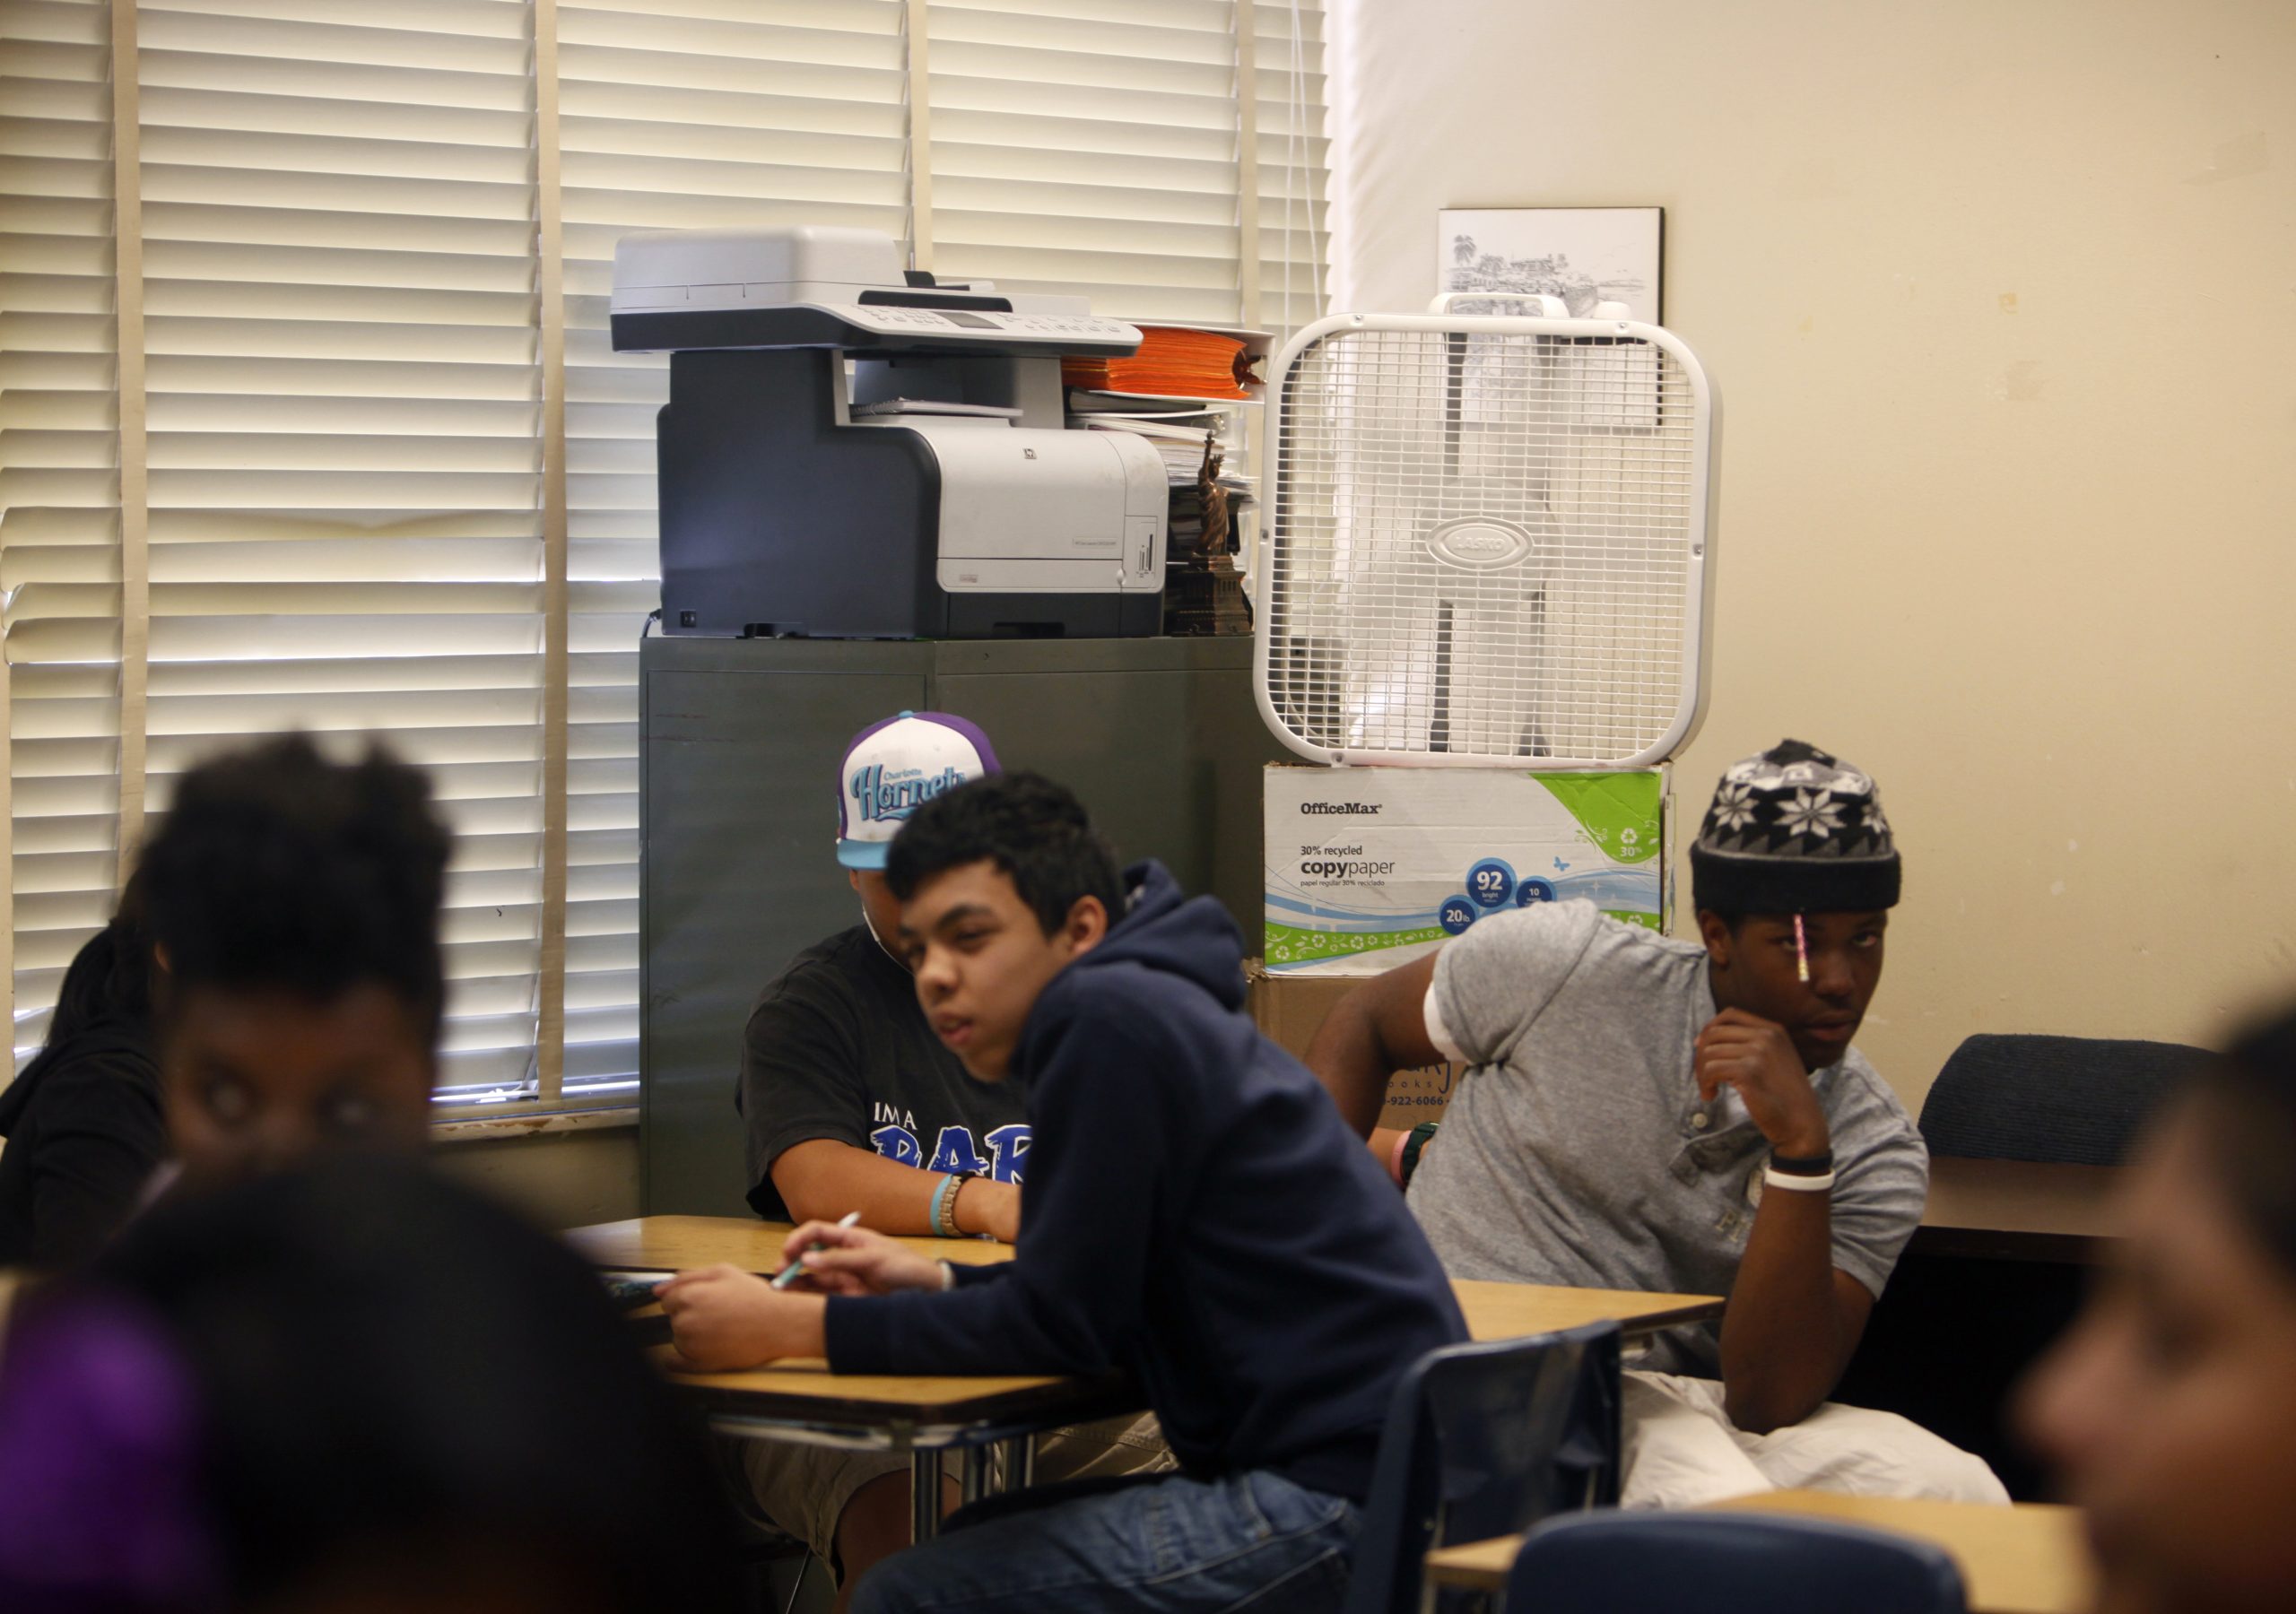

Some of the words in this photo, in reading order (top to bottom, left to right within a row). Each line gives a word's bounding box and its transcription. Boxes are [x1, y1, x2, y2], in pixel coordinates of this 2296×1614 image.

[1300, 846, 1321, 855] 30%
[1324, 846, 1362, 857] recycled
[1319, 880, 1341, 888] regular
[1476, 872, 1503, 890] 92
[1528, 888, 1540, 896] 10
[1388, 1079, 1432, 1088] ooks
